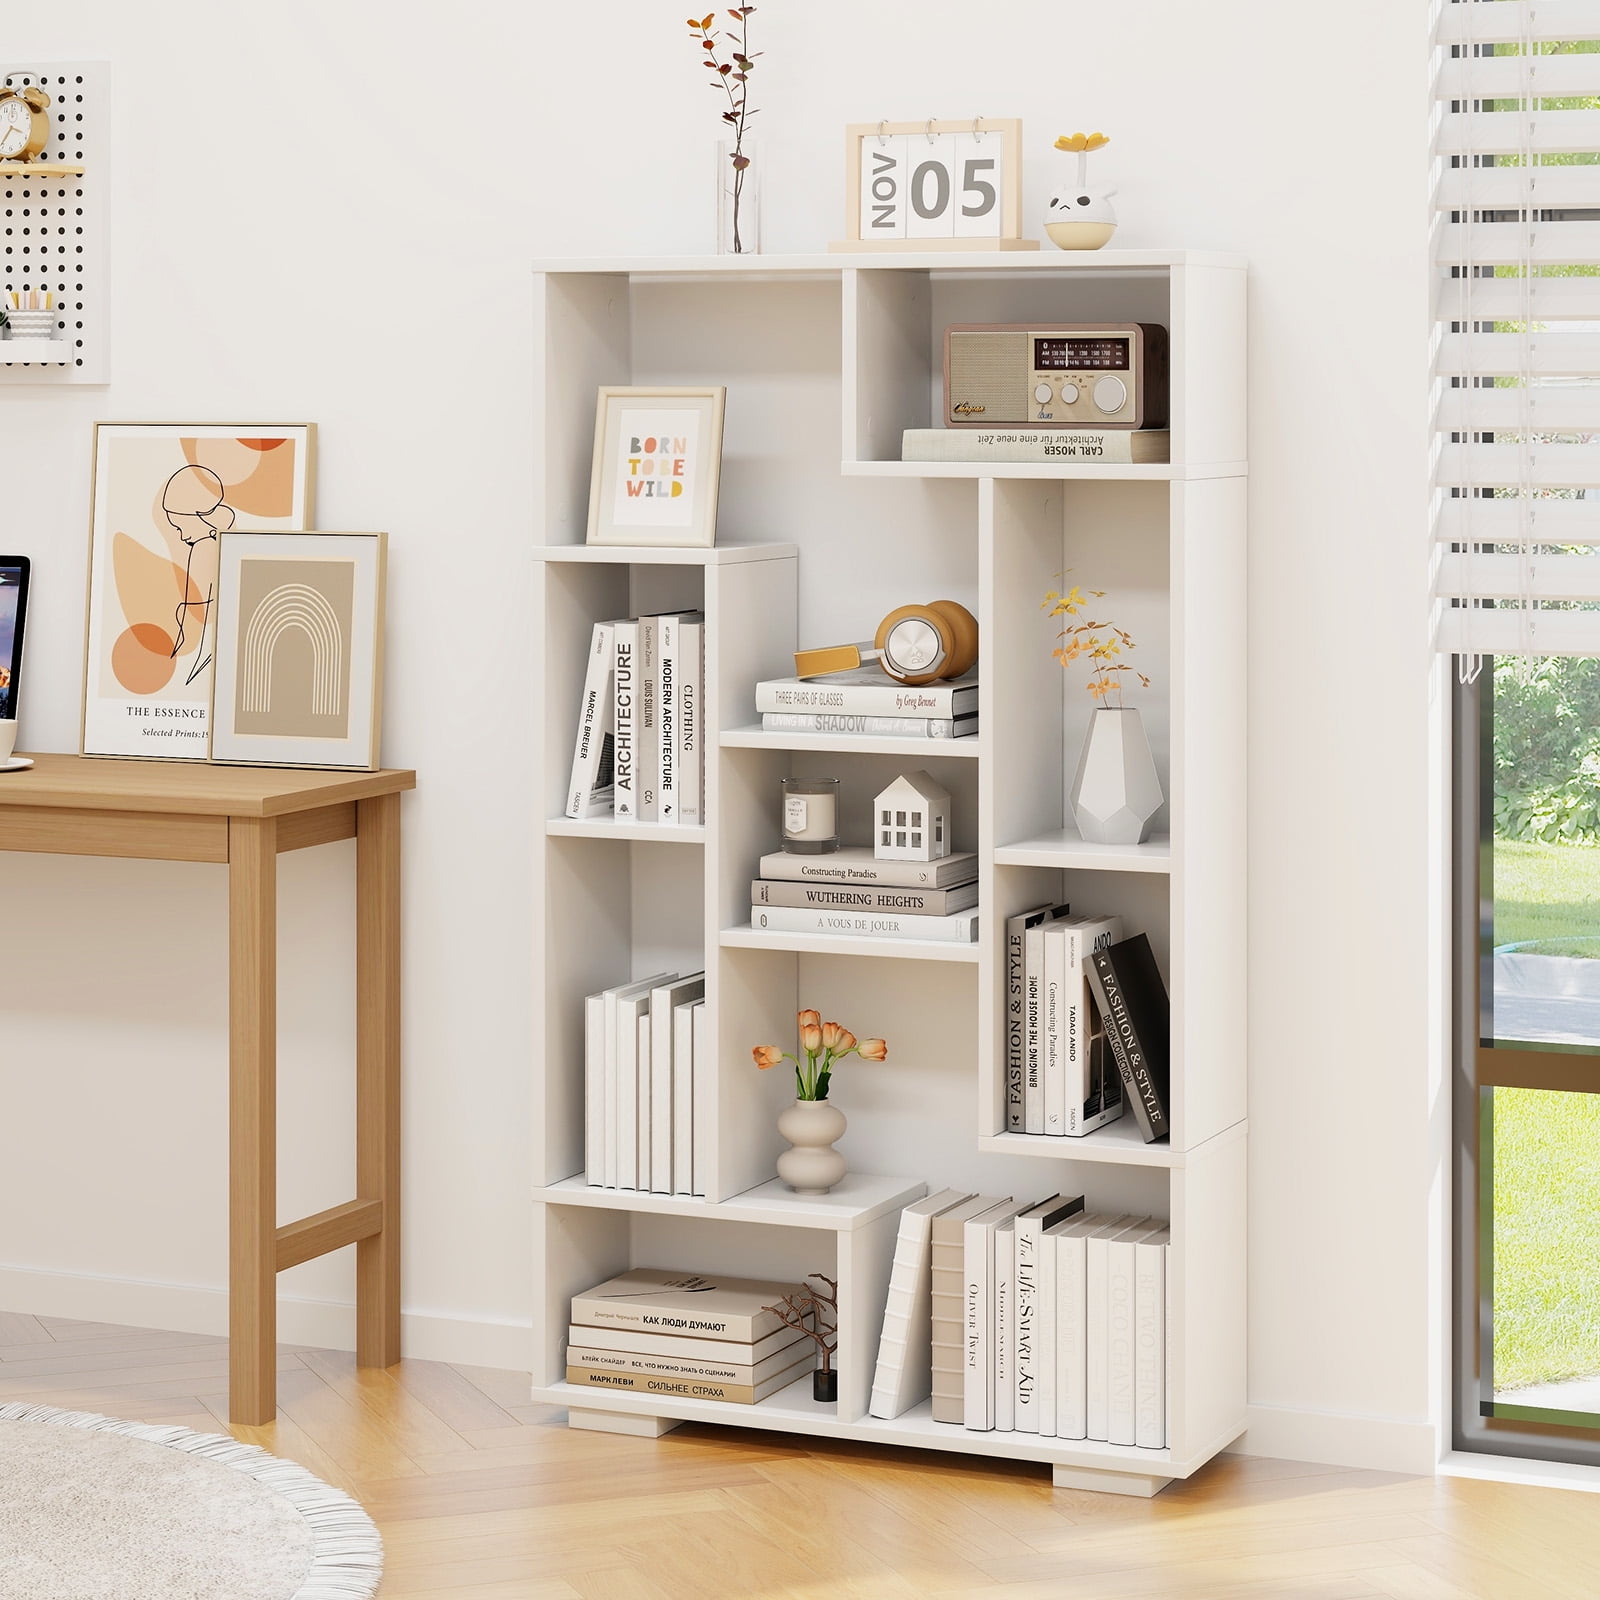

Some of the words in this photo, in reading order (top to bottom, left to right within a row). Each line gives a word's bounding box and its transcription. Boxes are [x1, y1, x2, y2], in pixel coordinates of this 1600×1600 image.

[872, 152, 896, 228] NOV
[910, 158, 996, 220] 05
[630, 437, 686, 454] BORN
[978, 435, 993, 444] Zeit
[1041, 436, 1053, 445] für
[1055, 436, 1104, 445] Architektur
[1044, 446, 1076, 456] MOSER
[1081, 446, 1103, 456] CARL
[628, 458, 654, 475] TO
[660, 458, 685, 476] BE
[626, 480, 683, 497] WILD
[663, 659, 672, 705] MODERN
[585, 690, 596, 723] MARCEL
[776, 691, 792, 704] THREE
[794, 691, 809, 705] PAIRS
[811, 692, 818, 705] OF
[819, 692, 844, 706] GLASSES
[896, 694, 903, 710] by
[904, 694, 917, 710] Greg
[126, 706, 150, 716] THE
[154, 708, 206, 718] ESSENCE
[618, 644, 631, 790] ARCHITECTURE
[684, 685, 693, 751] CLOTHING
[142, 728, 173, 737] Selected
[815, 715, 867, 732] SHADOW
[580, 725, 591, 759] BREUER
[663, 708, 672, 790] ARCHITECTURE
[802, 866, 846, 879] Constructing
[848, 868, 877, 879] Paradies
[806, 891, 872, 905] WUTHERING
[877, 895, 924, 908] HEIGHTS
[817, 918, 824, 928] A
[827, 918, 852, 929] VOUS
[855, 920, 867, 930] DE
[870, 920, 900, 932] JOUER
[1094, 931, 1112, 953] ANDO
[1011, 935, 1021, 994] STYLE
[1011, 1000, 1021, 1014] &
[1048, 982, 1057, 1032] Constructing
[1103, 974, 1136, 1049] FASHION
[1130, 1053, 1141, 1067] &
[1136, 1068, 1162, 1123] STYLE
[1103, 1014, 1116, 1041] DESIGN
[1112, 1041, 1132, 1084] COLLECTION
[1011, 1020, 1021, 1104] FASHION
[969, 1284, 979, 1328] OLIVER
[643, 1316, 659, 1325] КАК
[662, 1318, 687, 1328] ЛЮДИ
[689, 1321, 726, 1332] ДУМАЮТ
[969, 1332, 979, 1368] TWIST
[601, 1357, 626, 1365] СНАЙДЕР
[705, 1369, 736, 1378] СЦЕНАРИИ
[590, 1375, 611, 1384] МАРК
[612, 1376, 634, 1386] ЛЕВИ
[648, 1381, 688, 1394] СИЛЬНЕЕ
[692, 1386, 725, 1398] СТРАХА
